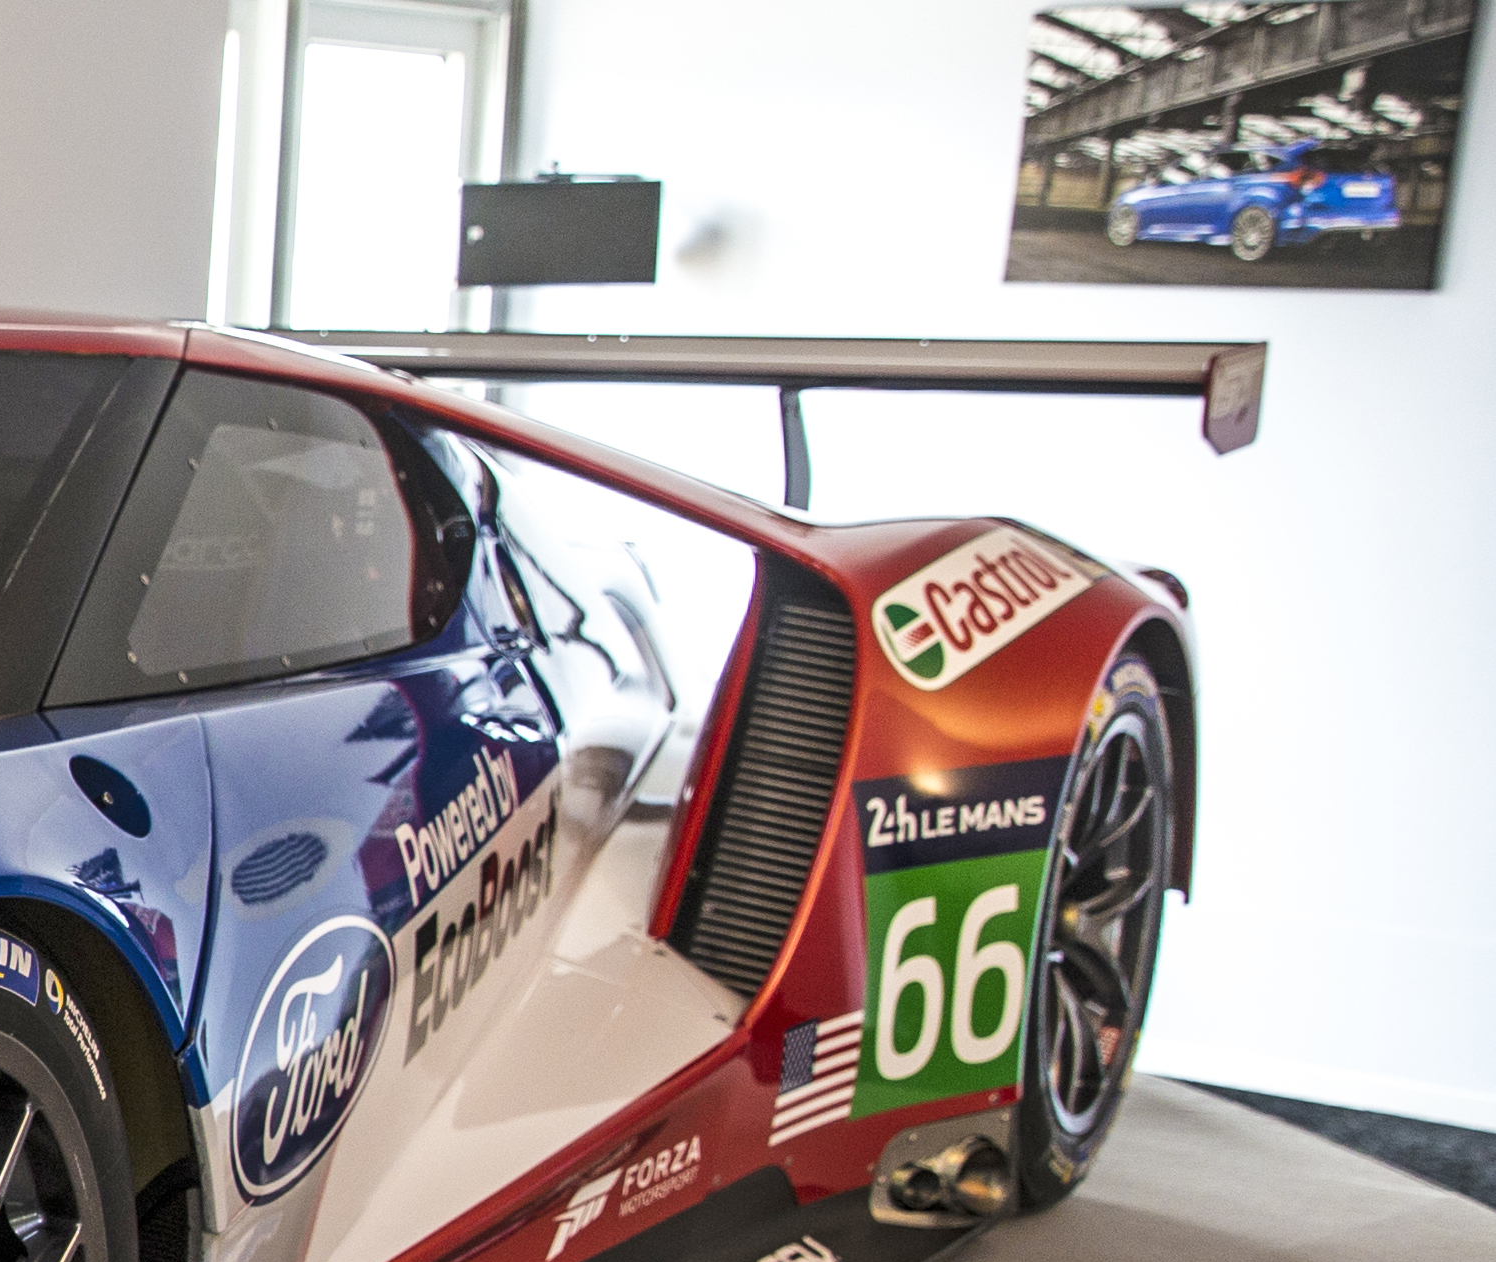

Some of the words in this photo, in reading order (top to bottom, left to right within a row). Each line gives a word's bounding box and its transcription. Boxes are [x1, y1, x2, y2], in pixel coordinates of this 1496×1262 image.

[923, 538, 1072, 653] Castrol
[395, 752, 498, 907] Powered
[481, 746, 520, 821] by
[921, 806, 957, 840] LE
[959, 795, 1046, 834] MANS
[403, 788, 557, 1069] EcoBoost
[874, 883, 1025, 1082] 66
[64, 1009, 79, 1037] Total
[77, 1032, 107, 1101] Performance
[262, 954, 369, 1166] Ford
[622, 1134, 701, 1197] FORZA
